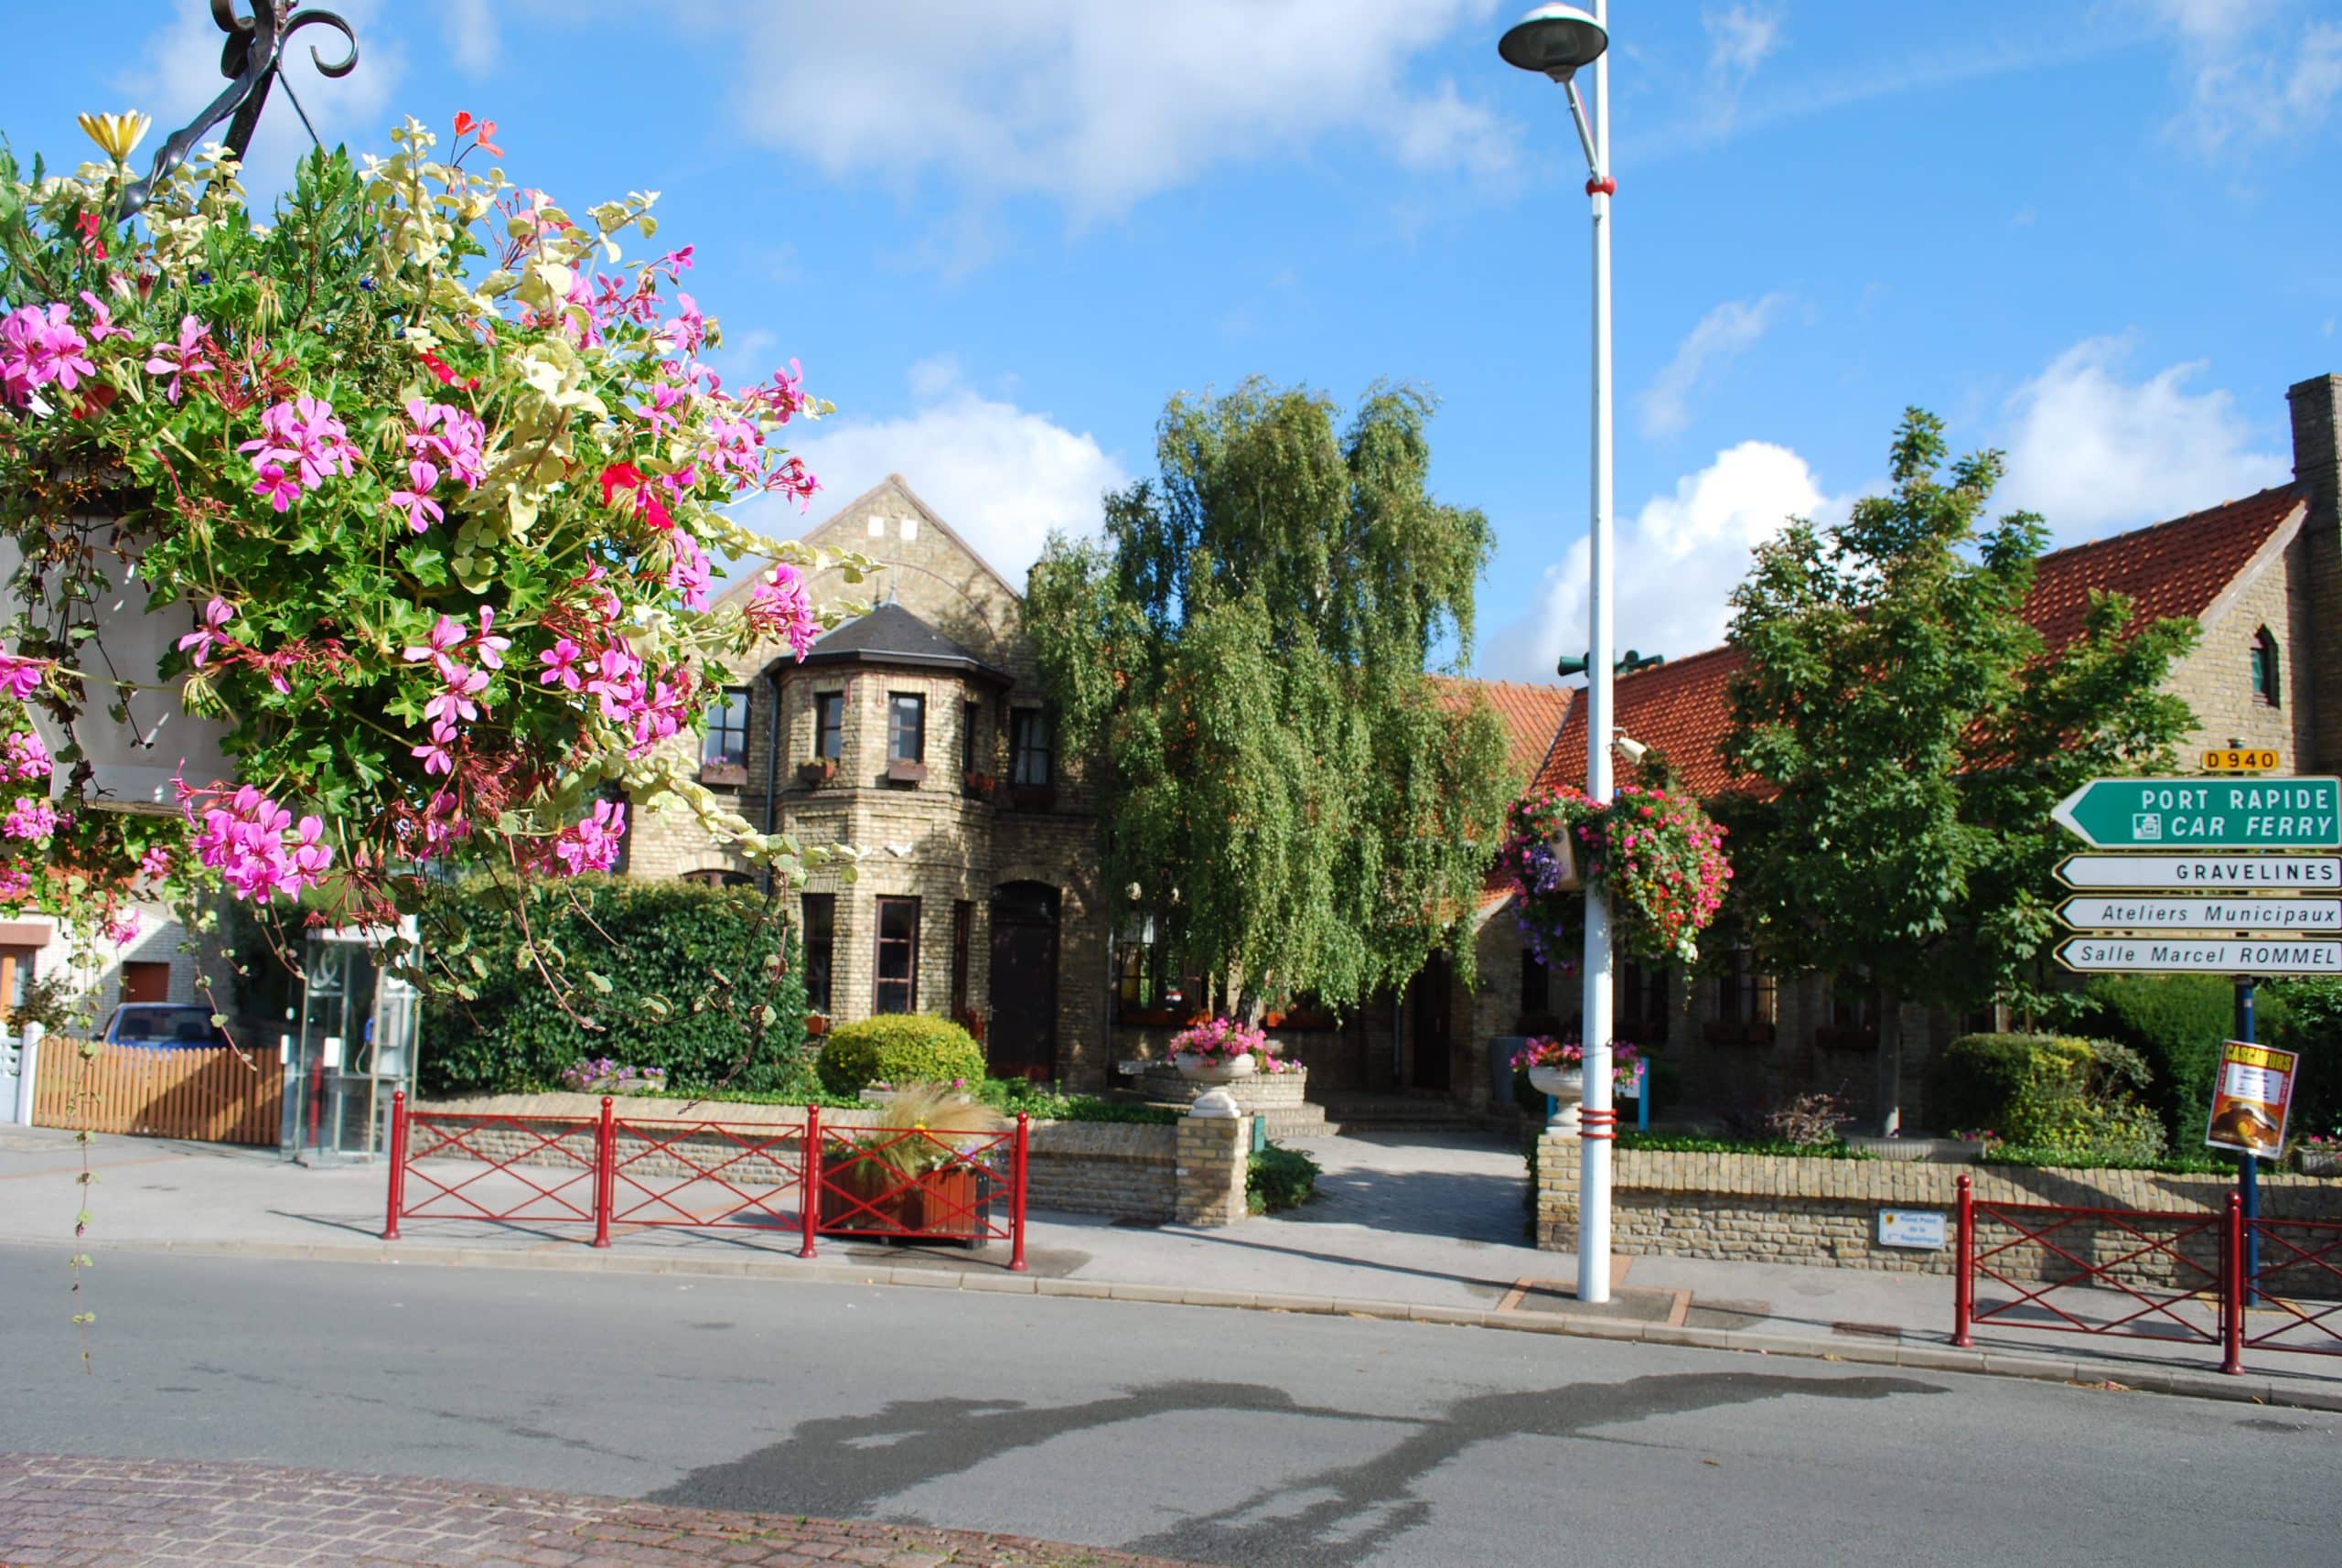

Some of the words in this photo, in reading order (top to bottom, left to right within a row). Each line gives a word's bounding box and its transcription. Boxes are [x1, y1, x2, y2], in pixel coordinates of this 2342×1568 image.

[2208, 753, 2218, 768] D
[2228, 753, 2274, 768] 940
[2142, 789, 2208, 810] PORT
[2229, 789, 2328, 809] RAPIDE
[2171, 816, 2225, 836] CAR
[2246, 816, 2333, 836] FERRY
[2175, 865, 2333, 880] GRAVELINES
[2101, 905, 2187, 921] Ateliers
[2204, 906, 2336, 925] Municipaux
[2080, 946, 2135, 961] Salle
[2151, 946, 2225, 962] Marcel
[2240, 947, 2336, 964] ROMMEL
